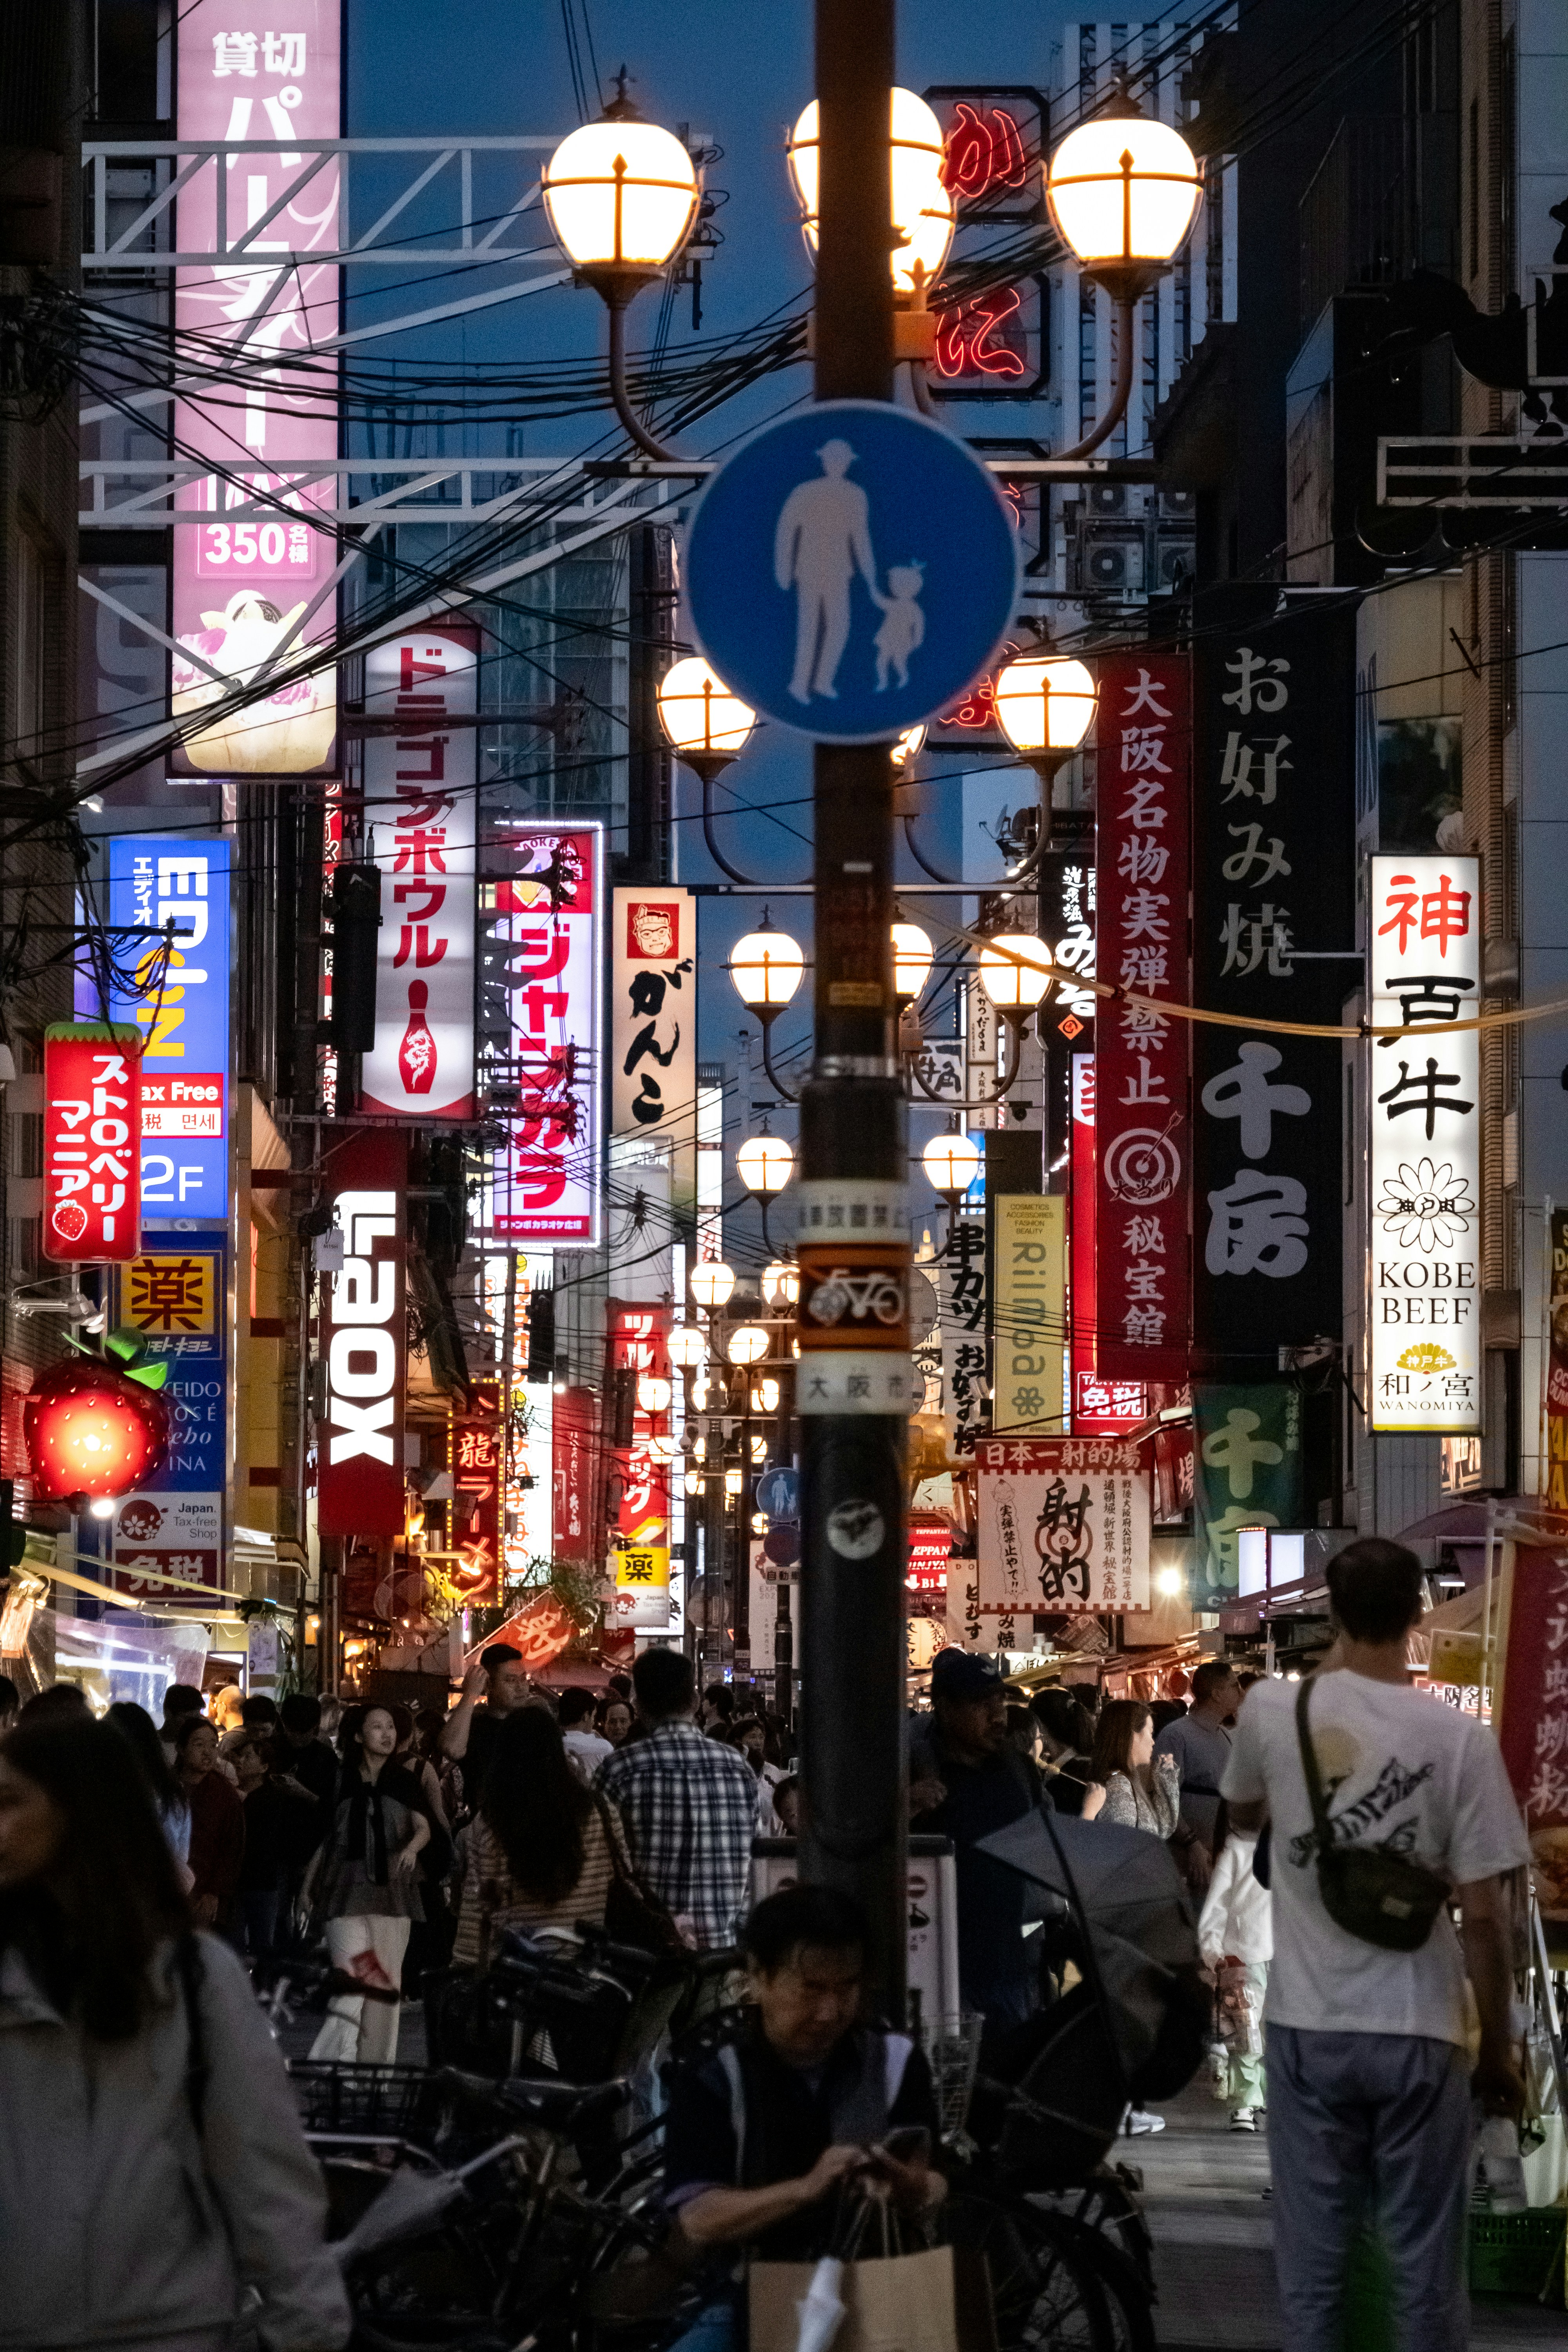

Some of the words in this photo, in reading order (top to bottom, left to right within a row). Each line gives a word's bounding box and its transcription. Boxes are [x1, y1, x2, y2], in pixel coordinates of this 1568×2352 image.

[212, 31, 306, 77] 貸切
[207, 474, 305, 511] MAX
[205, 523, 287, 564] 350
[289, 525, 308, 564] 名様
[1219, 647, 1295, 978] お好み焼
[1116, 668, 1173, 1105] 大阪名物実弾禁止
[1377, 874, 1476, 1142] 神戸牛
[623, 958, 694, 1124] がんこ
[142, 1085, 165, 1101] ax
[171, 1082, 218, 1101] Free
[142, 1113, 161, 1130] 税
[51, 1100, 91, 1197] マニア
[89, 1055, 132, 1242] ストロベリー
[141, 1155, 203, 1202] 2F
[131, 1259, 203, 1330] 薬
[942, 1222, 985, 1330] 串カツ
[1122, 1215, 1167, 1345] 秘宝館
[1378, 1262, 1475, 1289] KOBE
[1381, 1298, 1472, 1324] BEEF
[163, 1381, 221, 1397] EIDO
[1082, 1387, 1142, 1416] 免税
[1379, 1401, 1475, 1411] WANOMIYA
[624, 1315, 655, 1514] ツルラッグ
[169, 1456, 206, 1471] INA
[985, 1441, 1141, 1468] 日本一射的場
[456, 1396, 495, 1597] 龍ラーメン
[173, 1516, 217, 1526] Tax-free
[189, 1529, 217, 1540] Shop
[1036, 1476, 1094, 1602] 射的
[626, 1553, 653, 1581] 薬
[912, 1546, 950, 1556] EPPAN
[128, 1555, 205, 1592] 免税
[922, 1578, 935, 1588] B1
